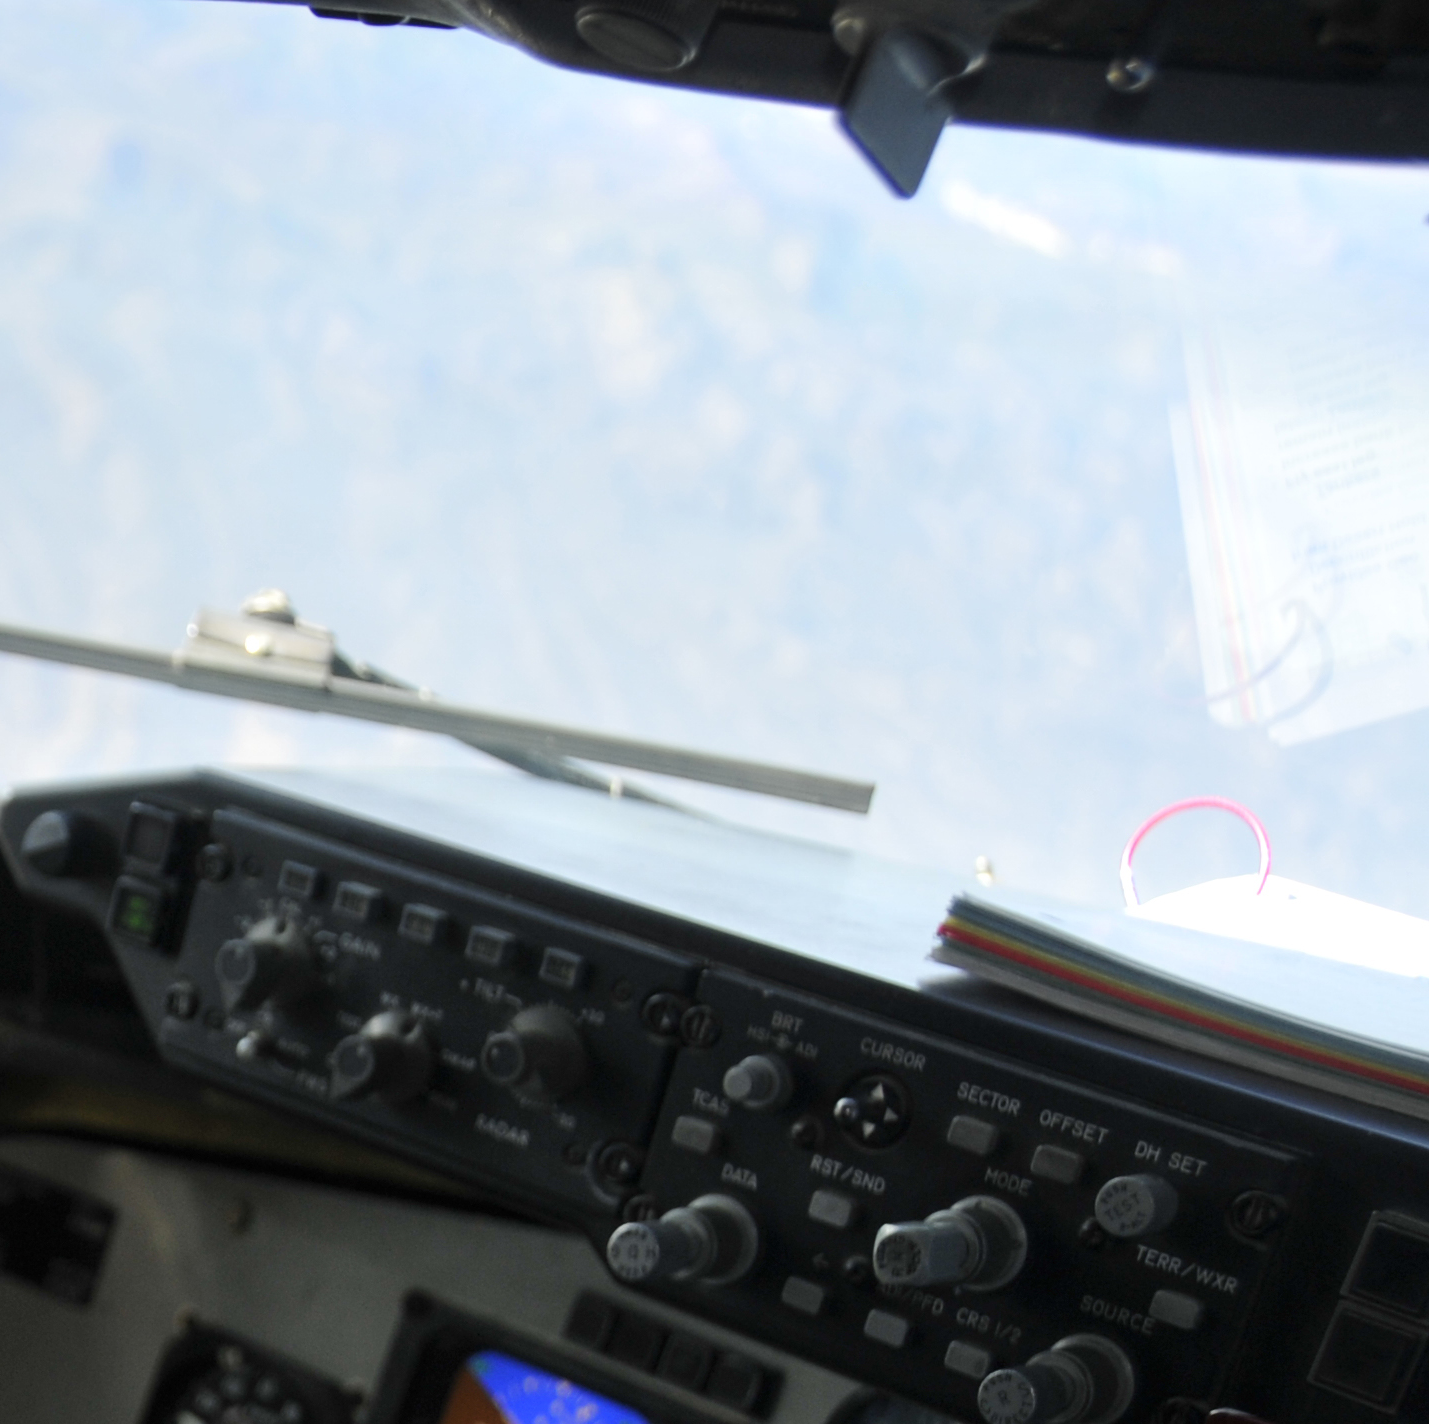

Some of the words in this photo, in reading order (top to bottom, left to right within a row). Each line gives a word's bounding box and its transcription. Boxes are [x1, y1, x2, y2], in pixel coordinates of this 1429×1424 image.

[771, 1009, 804, 1035] BRT
[860, 1036, 926, 1072] CURSOR
[692, 1087, 731, 1117] TCAS
[957, 1081, 1021, 1116] SECTOR
[1039, 1108, 1109, 1145] OFFSET
[809, 1153, 886, 1195] RST/SND
[1134, 1140, 1161, 1163] DH
[1168, 1151, 1208, 1176] SET
[721, 1162, 758, 1191] DATA
[984, 1166, 1033, 1197] MODE
[1135, 1244, 1238, 1294] TERR/WXR
[1079, 1295, 1157, 1337] SOURCE
